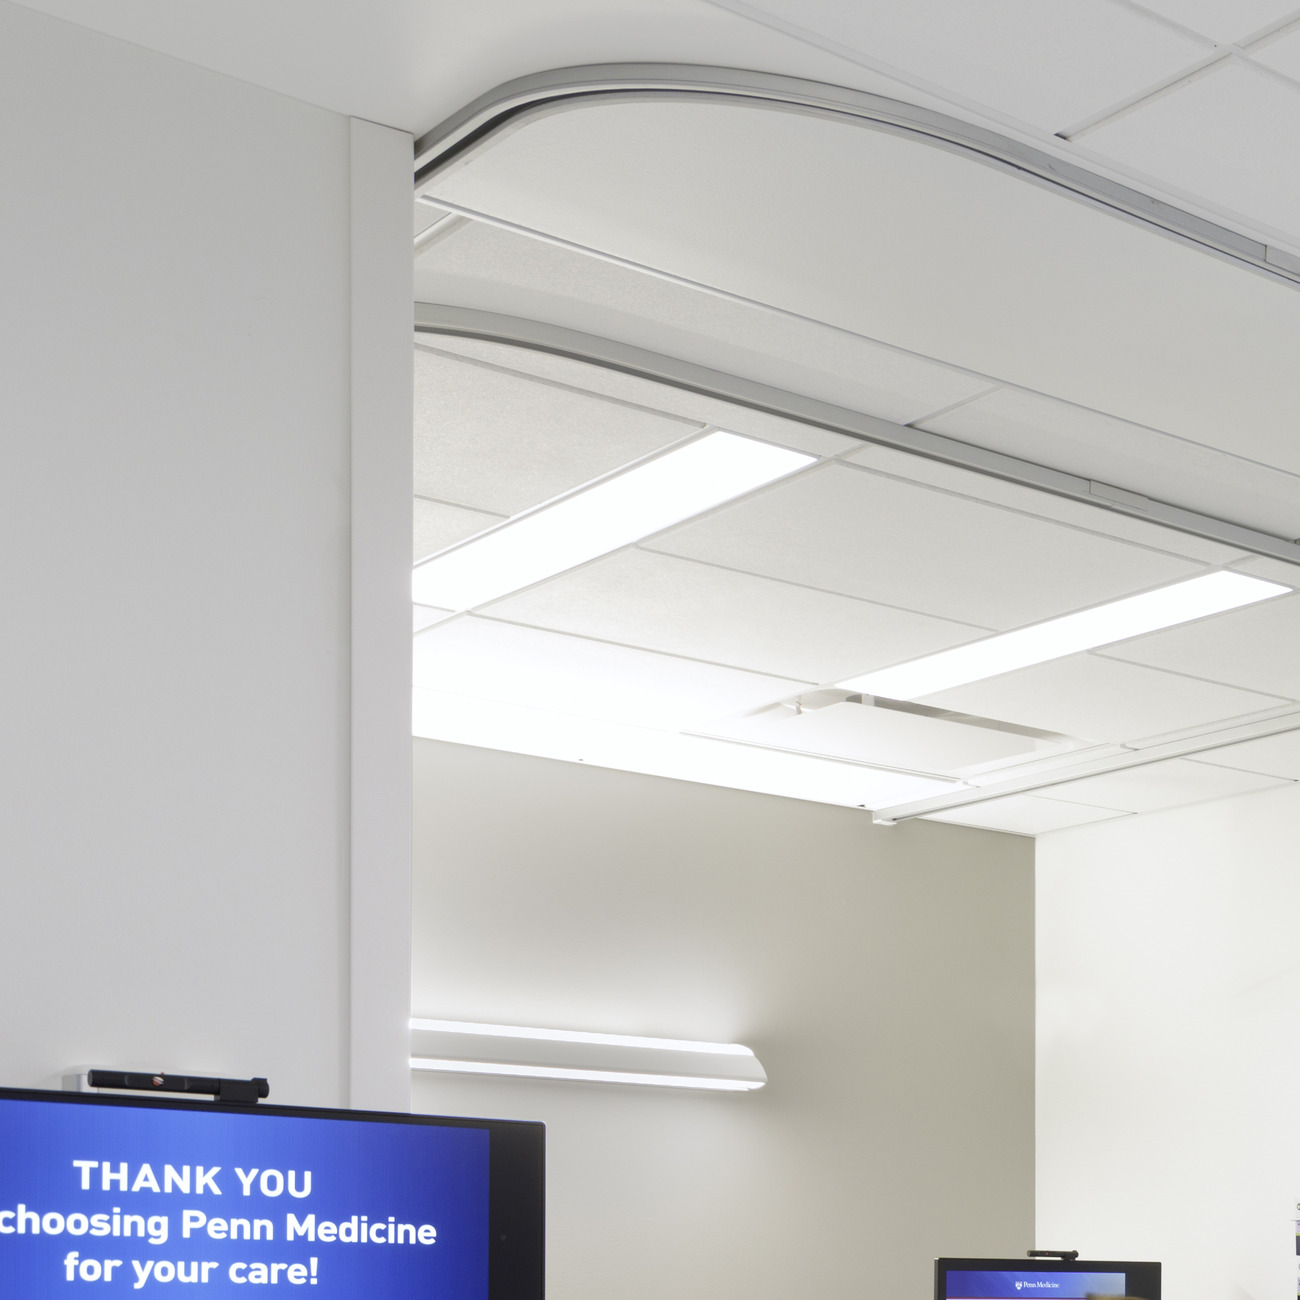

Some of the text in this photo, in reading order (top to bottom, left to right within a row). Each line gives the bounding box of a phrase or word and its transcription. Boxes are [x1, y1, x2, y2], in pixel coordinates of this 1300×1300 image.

[73, 1160, 312, 1198] THANK YOU
[0, 1203, 437, 1245] choosing Penn Medicine
[64, 1251, 319, 1289] for your care!
